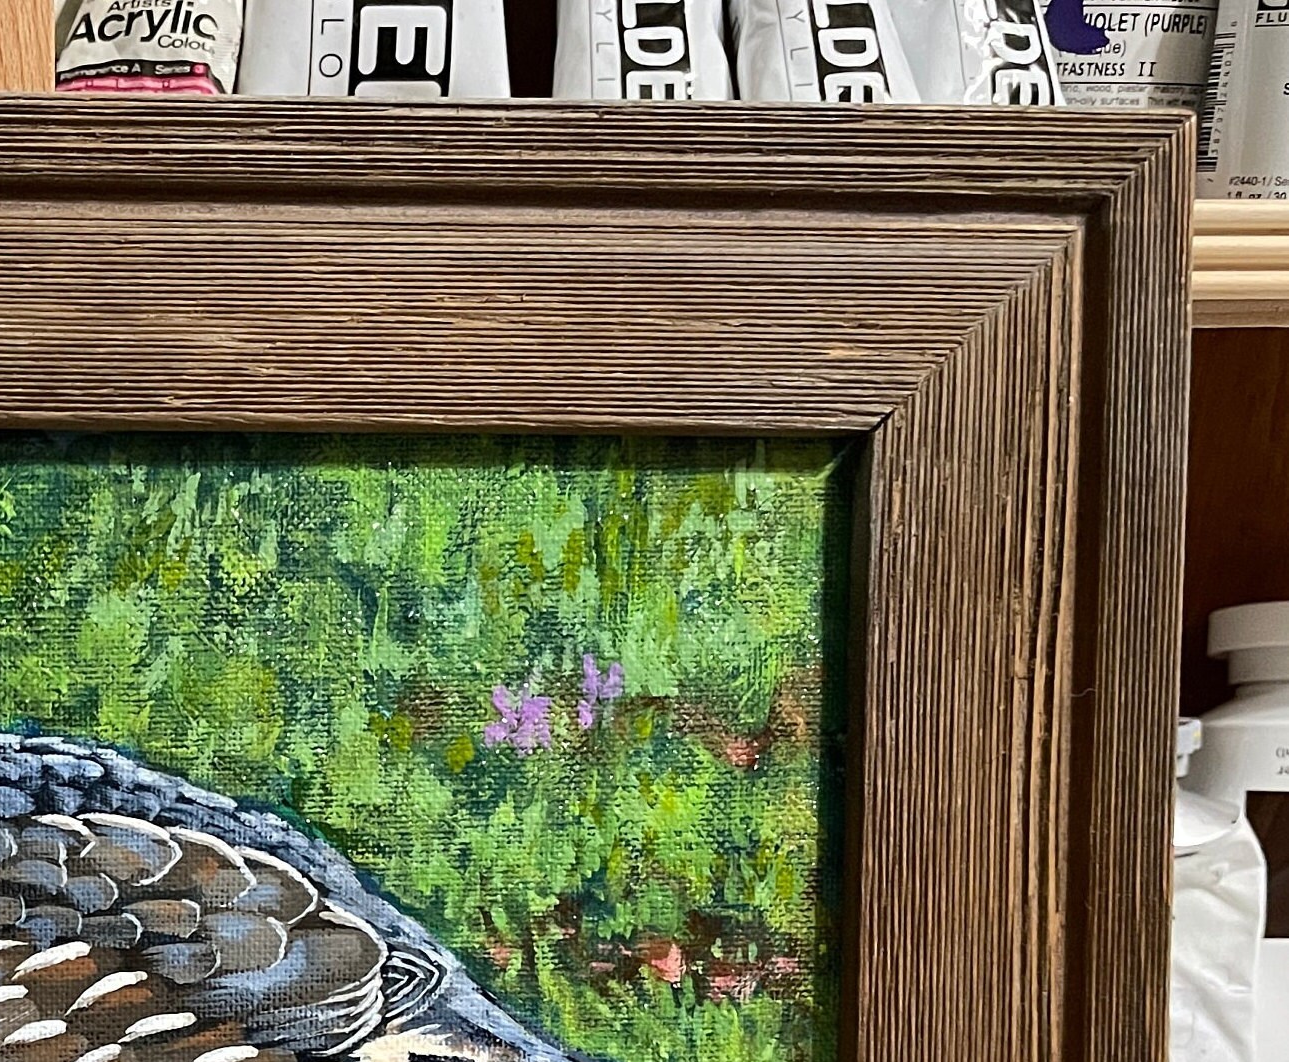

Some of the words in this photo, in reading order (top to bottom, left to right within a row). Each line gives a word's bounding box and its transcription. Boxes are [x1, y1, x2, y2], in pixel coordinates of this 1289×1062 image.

[69, 0, 219, 43] Acrylic
[1084, 12, 1141, 33] IOLET
[1144, 12, 1209, 38] (PURPLE)
